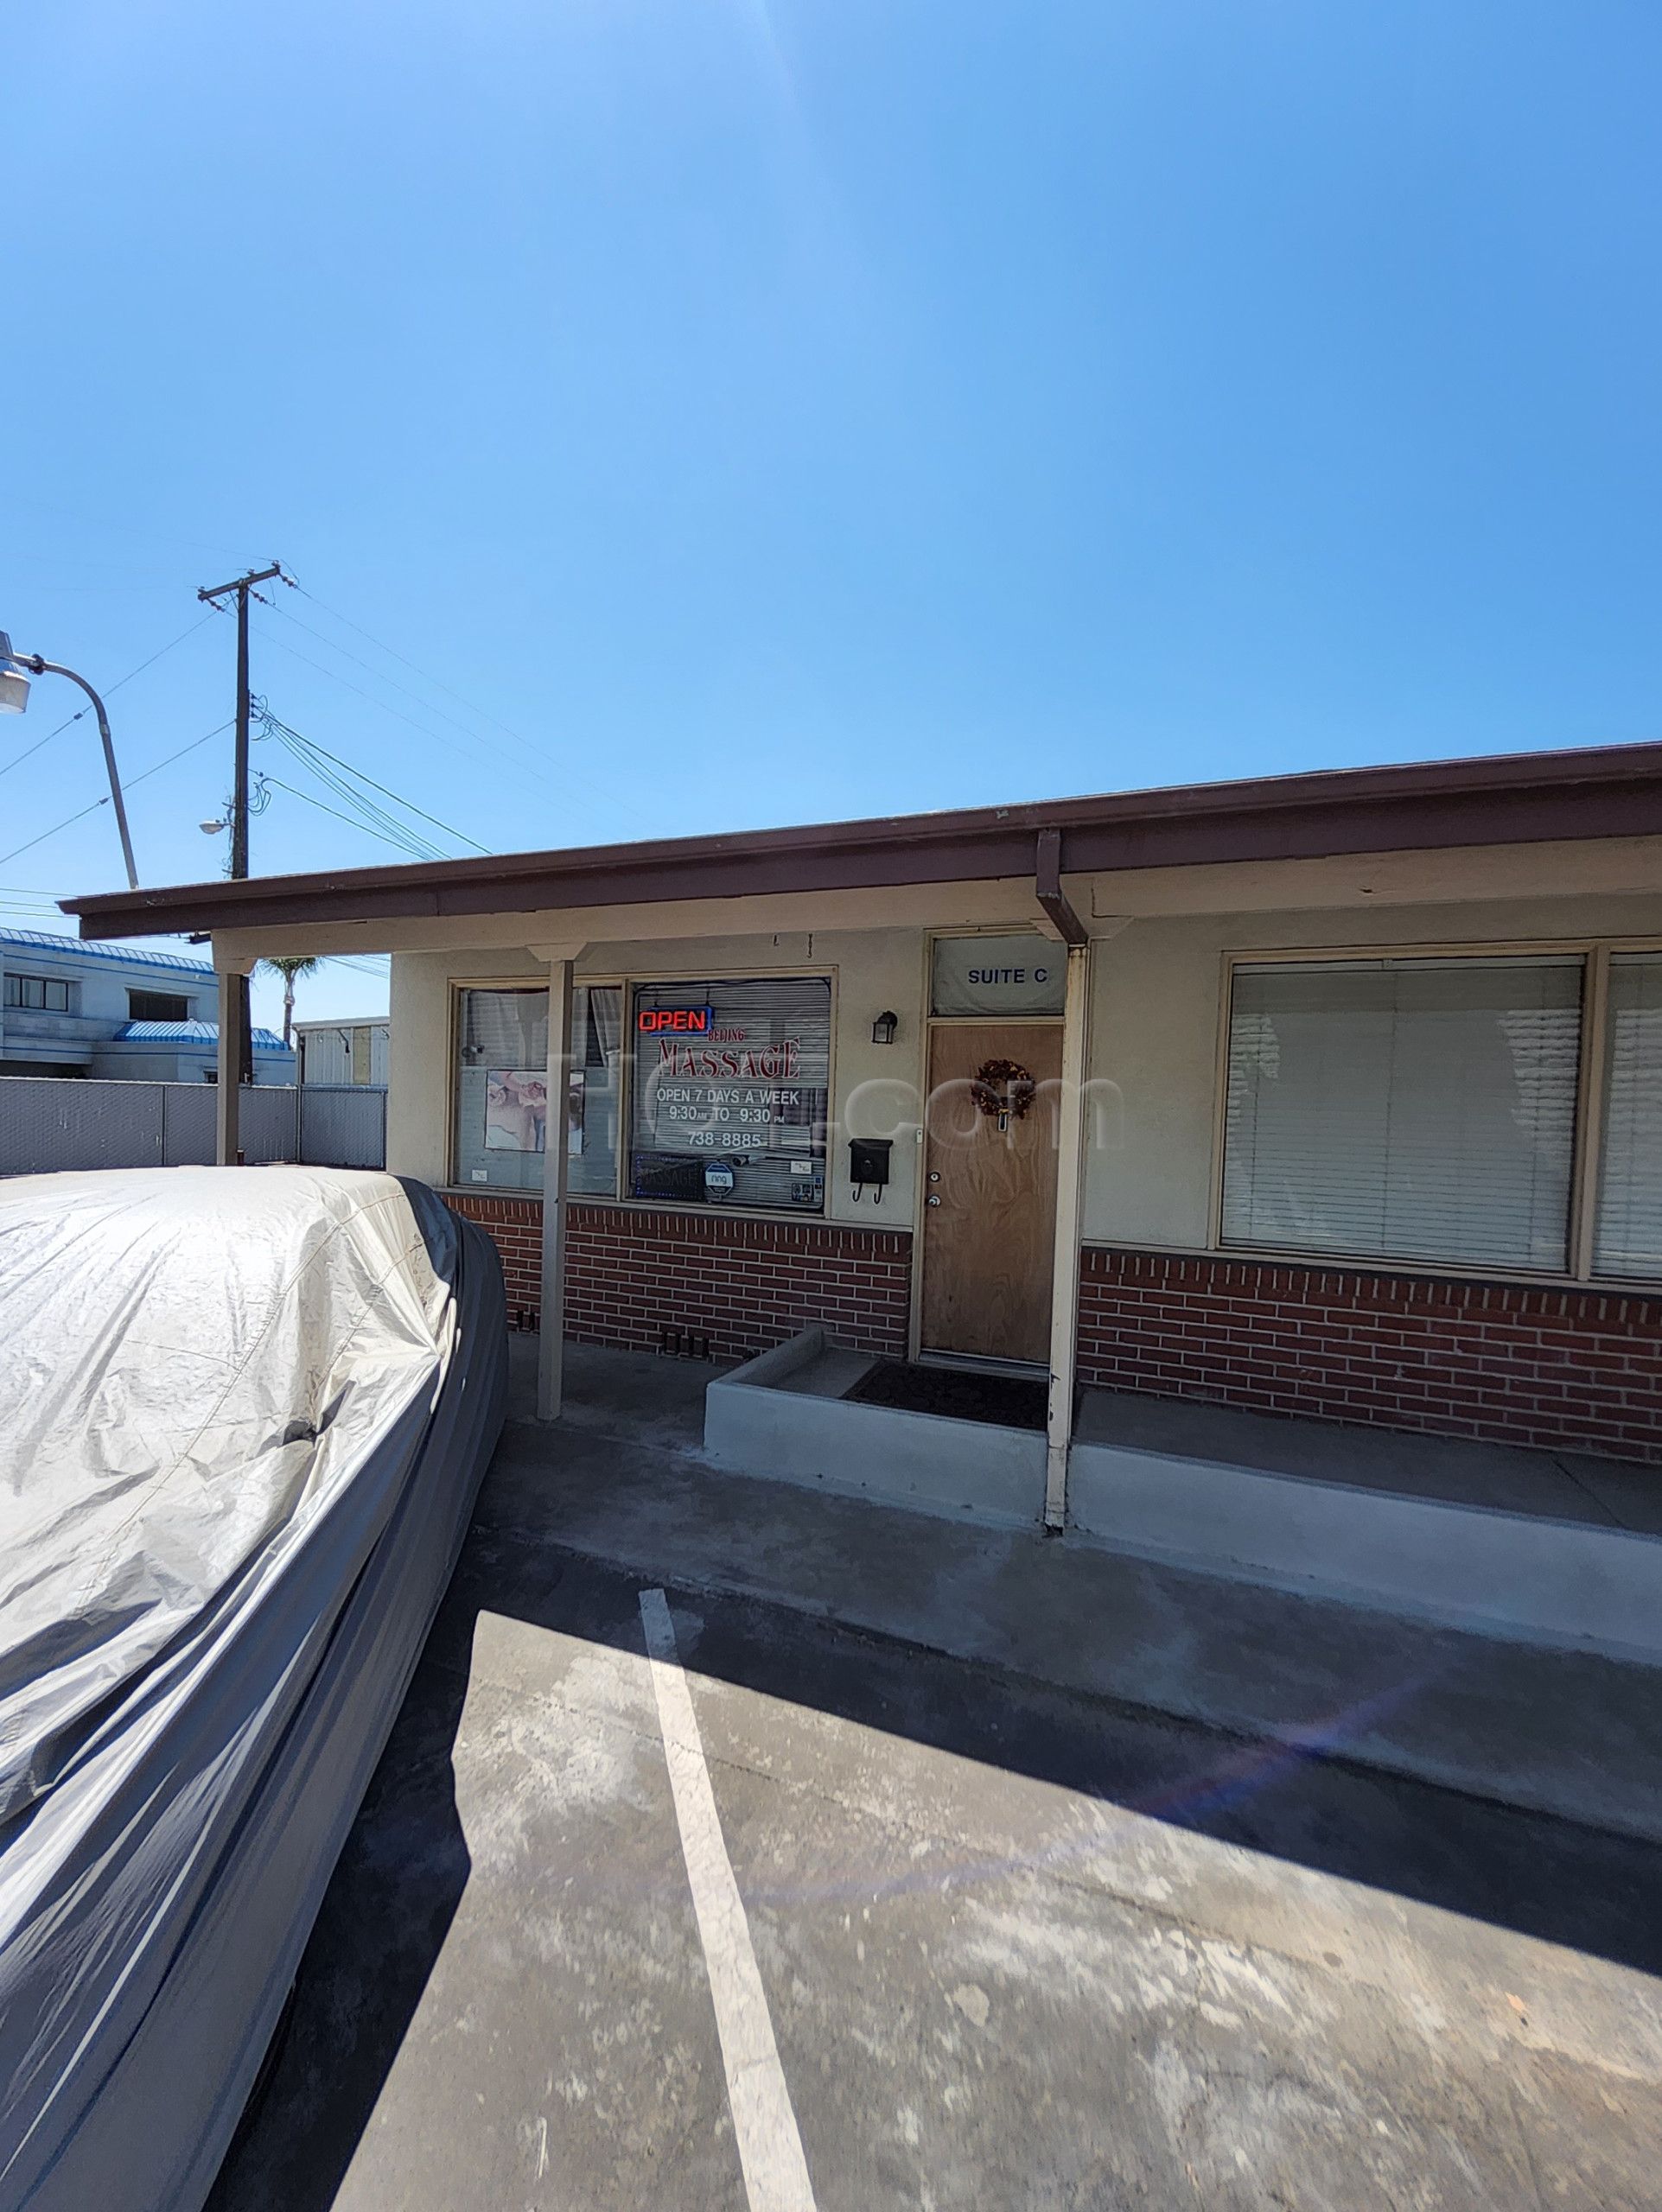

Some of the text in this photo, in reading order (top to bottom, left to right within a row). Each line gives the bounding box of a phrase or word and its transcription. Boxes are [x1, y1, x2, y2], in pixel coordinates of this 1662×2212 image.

[968, 968, 1048, 983] SUITE C
[639, 1011, 705, 1032] OPEN
[707, 1028, 747, 1043] BEIJING
[658, 1036, 801, 1079] MASSAGE
[657, 1088, 799, 1105] OPEN 7 DAYS A WEEK
[713, 1107, 730, 1122] TO
[740, 1108, 770, 1122] 9:30
[688, 1131, 761, 1147] 738-8885
